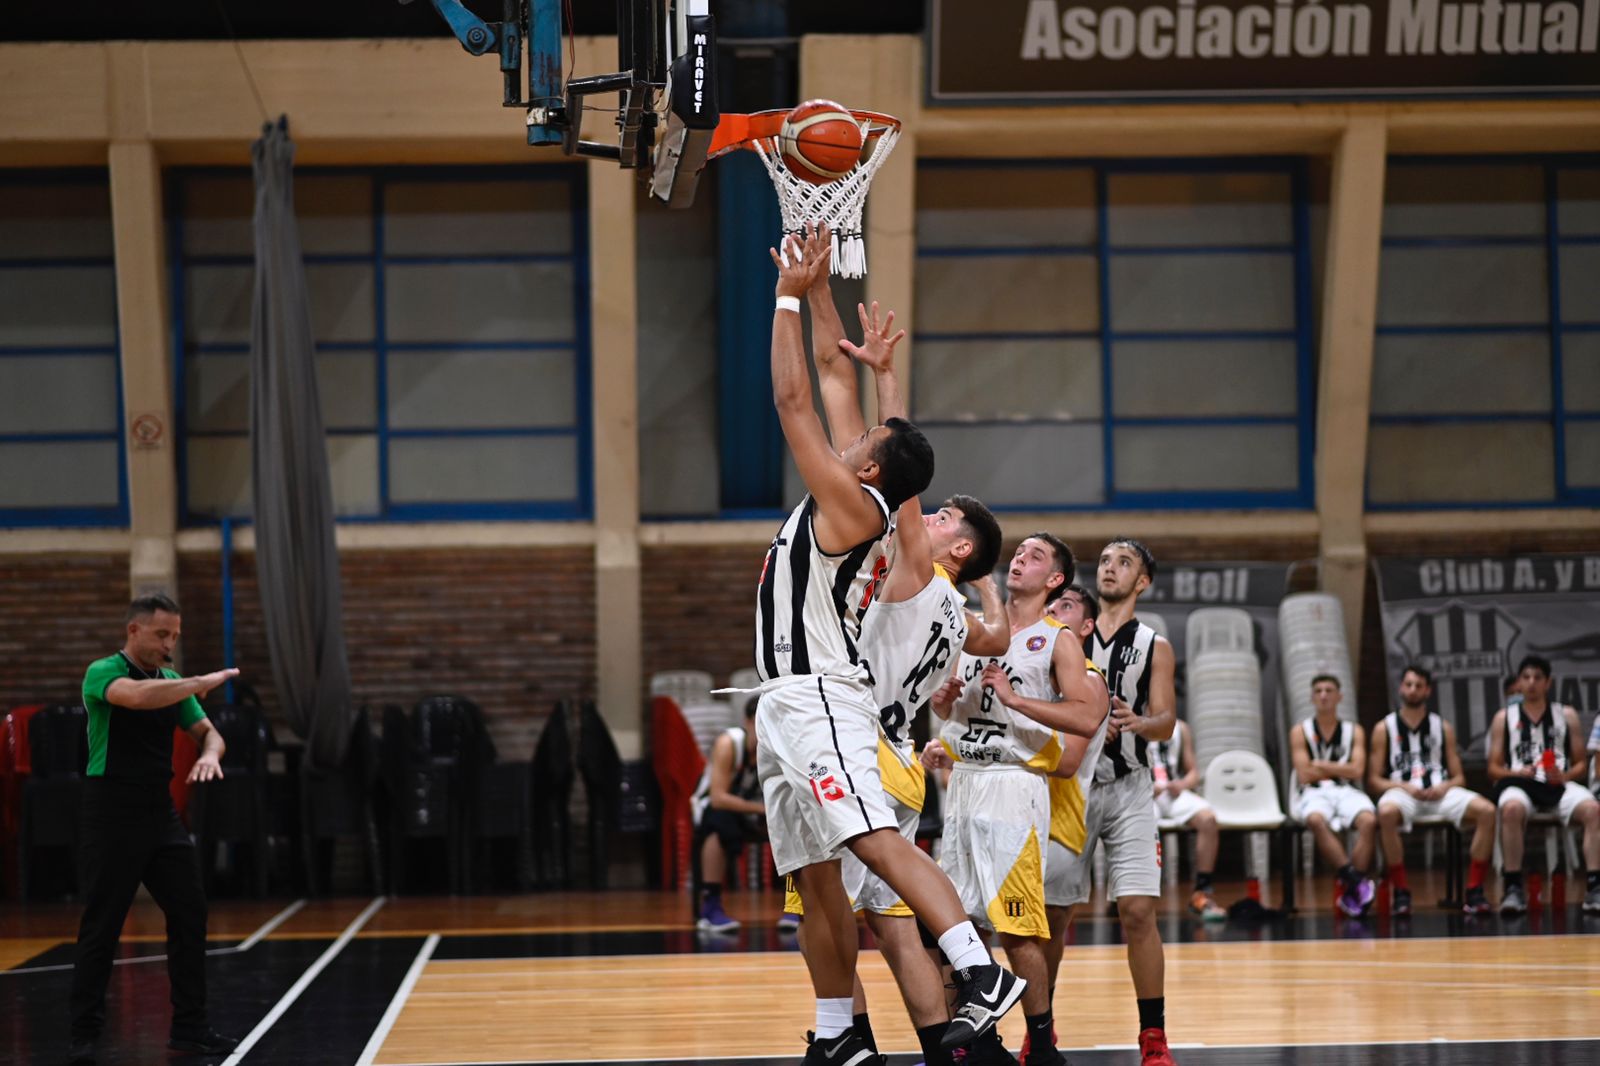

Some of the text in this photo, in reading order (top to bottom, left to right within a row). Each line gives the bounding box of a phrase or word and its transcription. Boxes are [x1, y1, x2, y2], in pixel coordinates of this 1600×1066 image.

[1020, 0, 1599, 59] Asociación Mutual
[694, 33, 707, 114] MIRAVET
[1173, 568, 1249, 603] Bell
[1419, 557, 1504, 595] Club
[1513, 557, 1546, 590] A.
[1554, 559, 1575, 591] y
[980, 684, 995, 713] 6
[809, 775, 846, 807] 15
